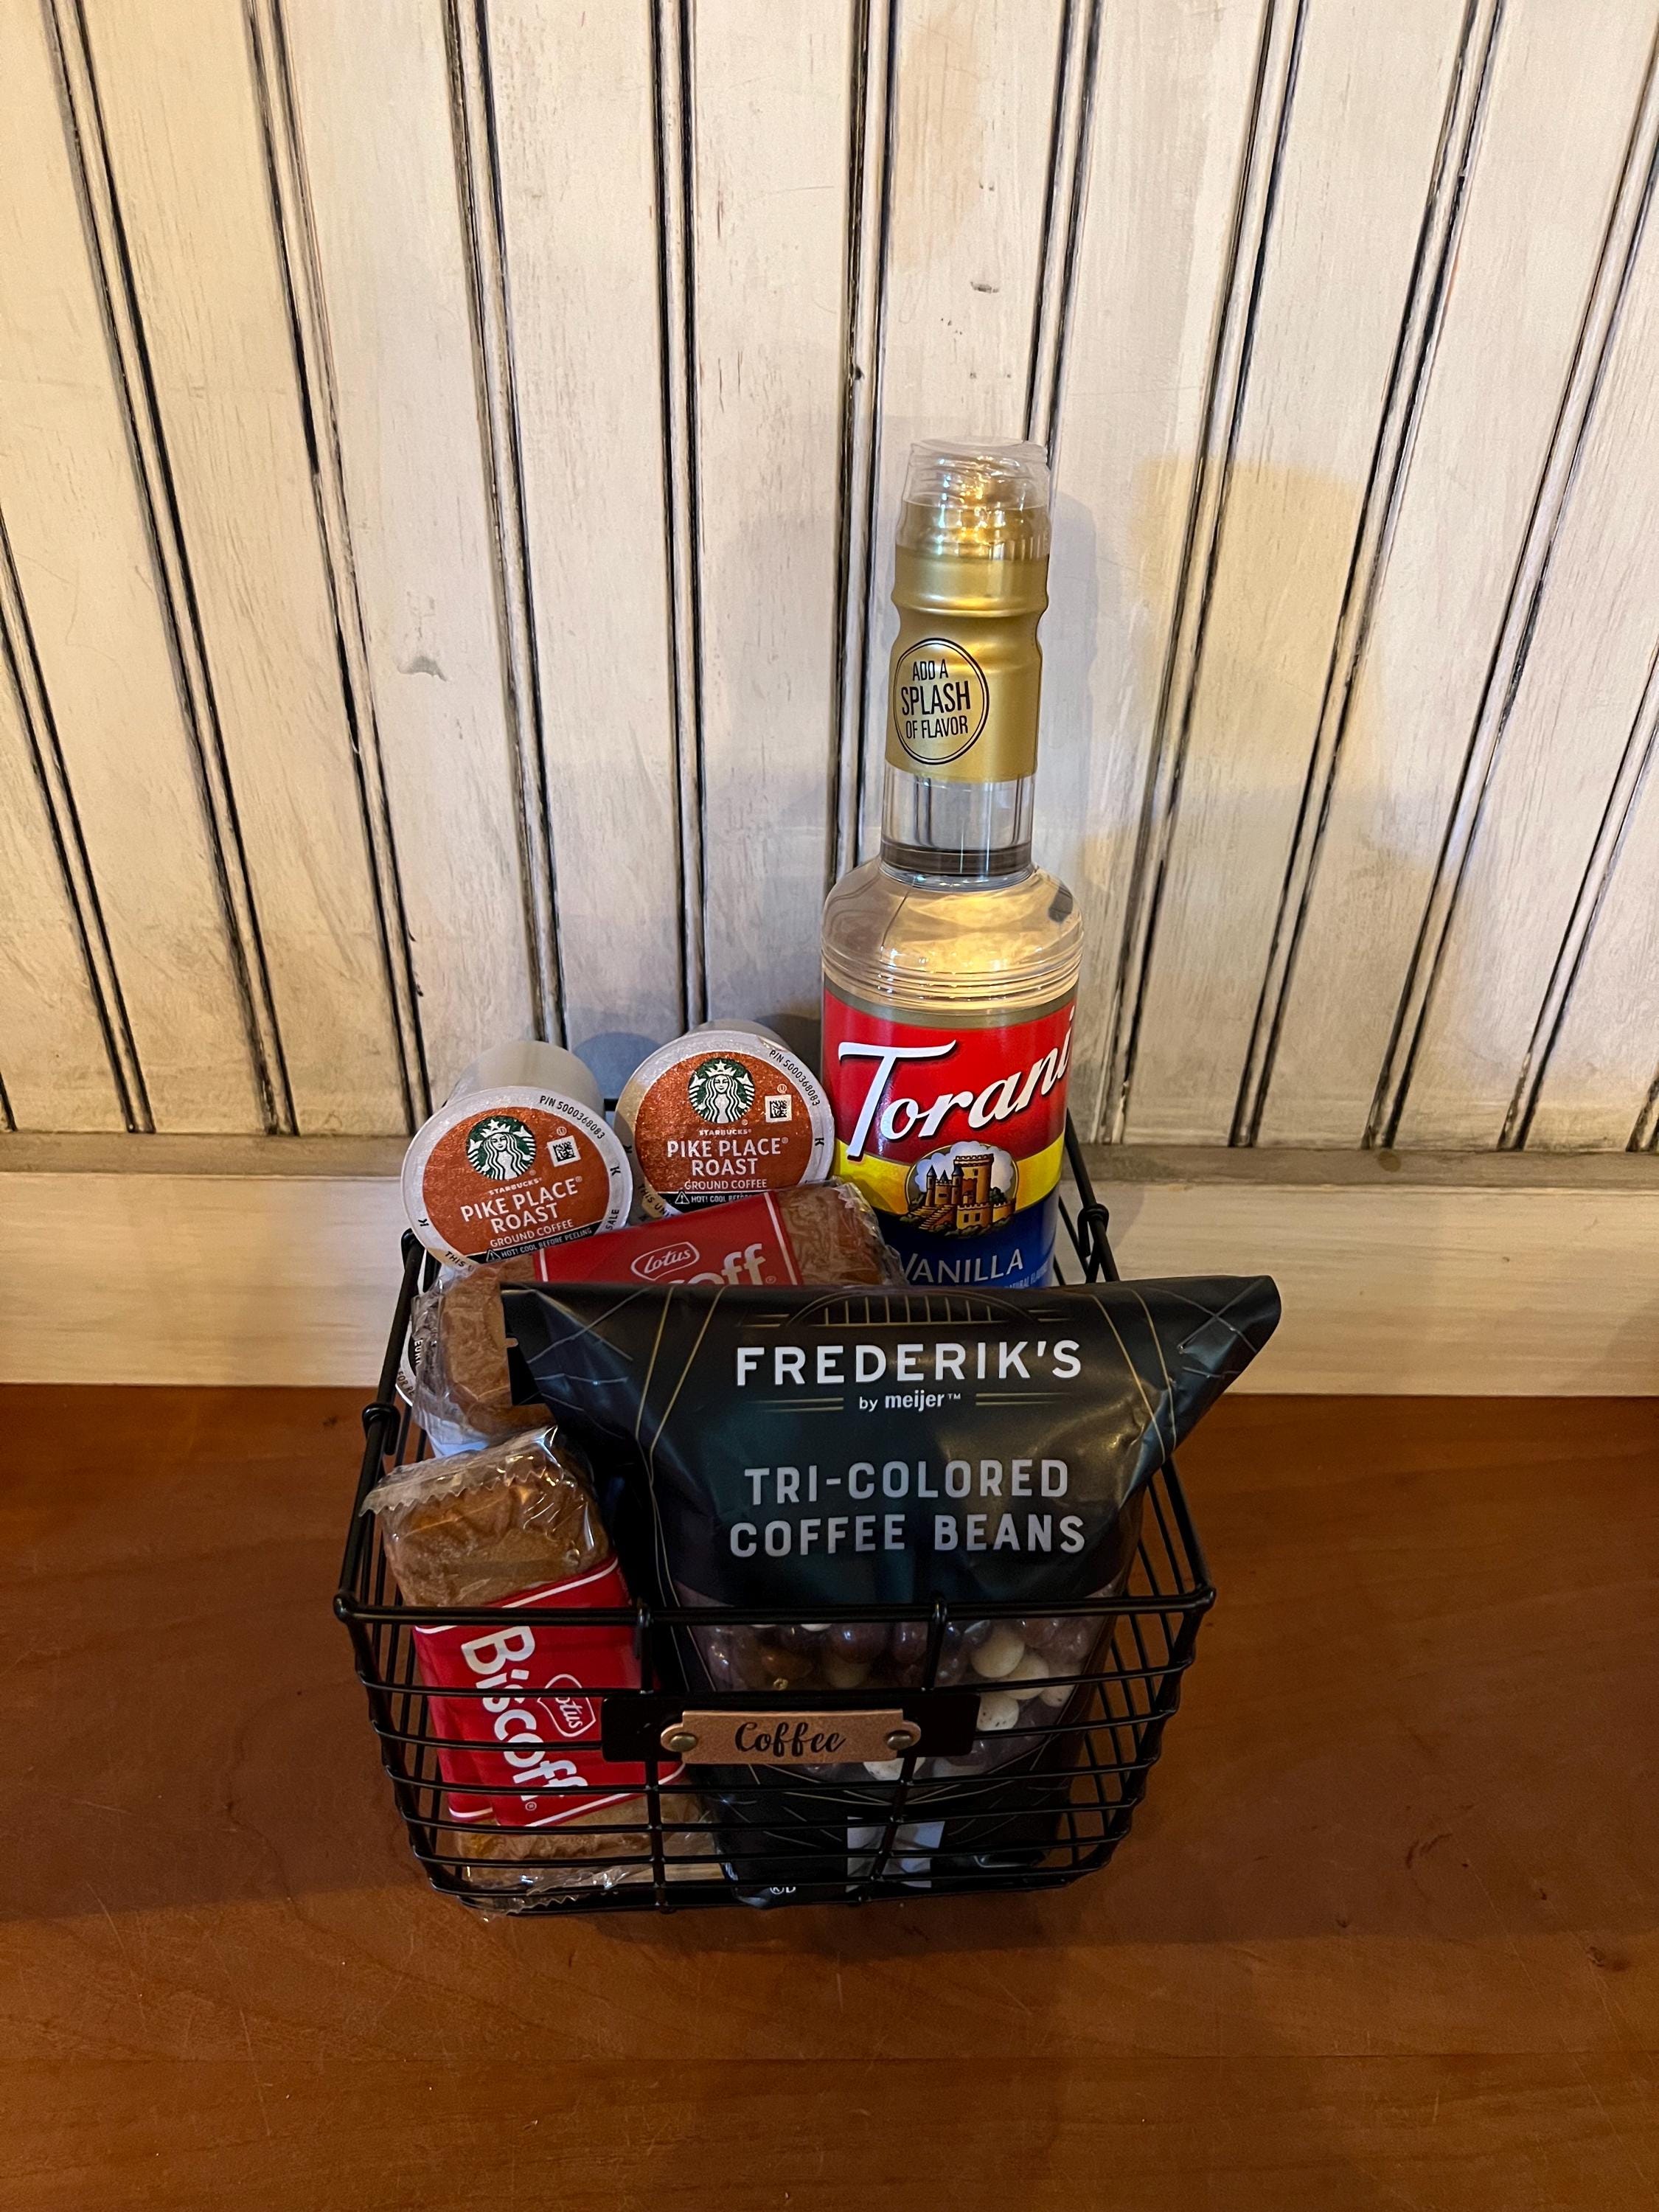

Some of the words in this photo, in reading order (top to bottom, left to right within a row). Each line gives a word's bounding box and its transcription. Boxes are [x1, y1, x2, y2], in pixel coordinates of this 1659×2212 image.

[912, 661, 936, 681] ADD
[939, 658, 949, 679] A
[900, 680, 972, 716] SPLASH
[905, 720, 919, 739] OF
[921, 715, 969, 739] FLAVOR
[768, 1049, 785, 1063] P/N
[783, 1060, 821, 1107] 5000368083
[838, 1006, 1075, 1157] Torani
[539, 1095, 555, 1107] P/N
[557, 1099, 605, 1140] 5000368083
[667, 1140, 712, 1158] PIKE
[692, 1158, 758, 1177] ROAST
[639, 1183, 655, 1203] THIS
[684, 1180, 728, 1191] GROUND
[731, 1179, 768, 1189] COFFEE
[691, 1195, 708, 1203] HOT!
[460, 1197, 510, 1222] PIKE
[490, 1203, 558, 1234] ROAST
[605, 1208, 620, 1231] SALE
[490, 1229, 535, 1248] GROUND
[537, 1219, 574, 1235] COFFEE
[501, 1248, 518, 1258] HOT!
[520, 1244, 538, 1253] COOL
[539, 1237, 563, 1249] BEFORE
[565, 1228, 592, 1241] PEELING
[445, 1251, 466, 1267] THIS
[644, 1248, 692, 1274] Lotus
[904, 1248, 1023, 1284] VANILLA
[737, 1339, 1082, 1386] FREDERIK'S
[859, 1396, 879, 1413] by
[744, 1458, 1068, 1506] TRI-COLORED
[730, 1514, 905, 1558] COFFEE
[933, 1513, 1086, 1554] BEANS
[554, 1697, 583, 1728] otus
[734, 1721, 846, 1758] Coffee
